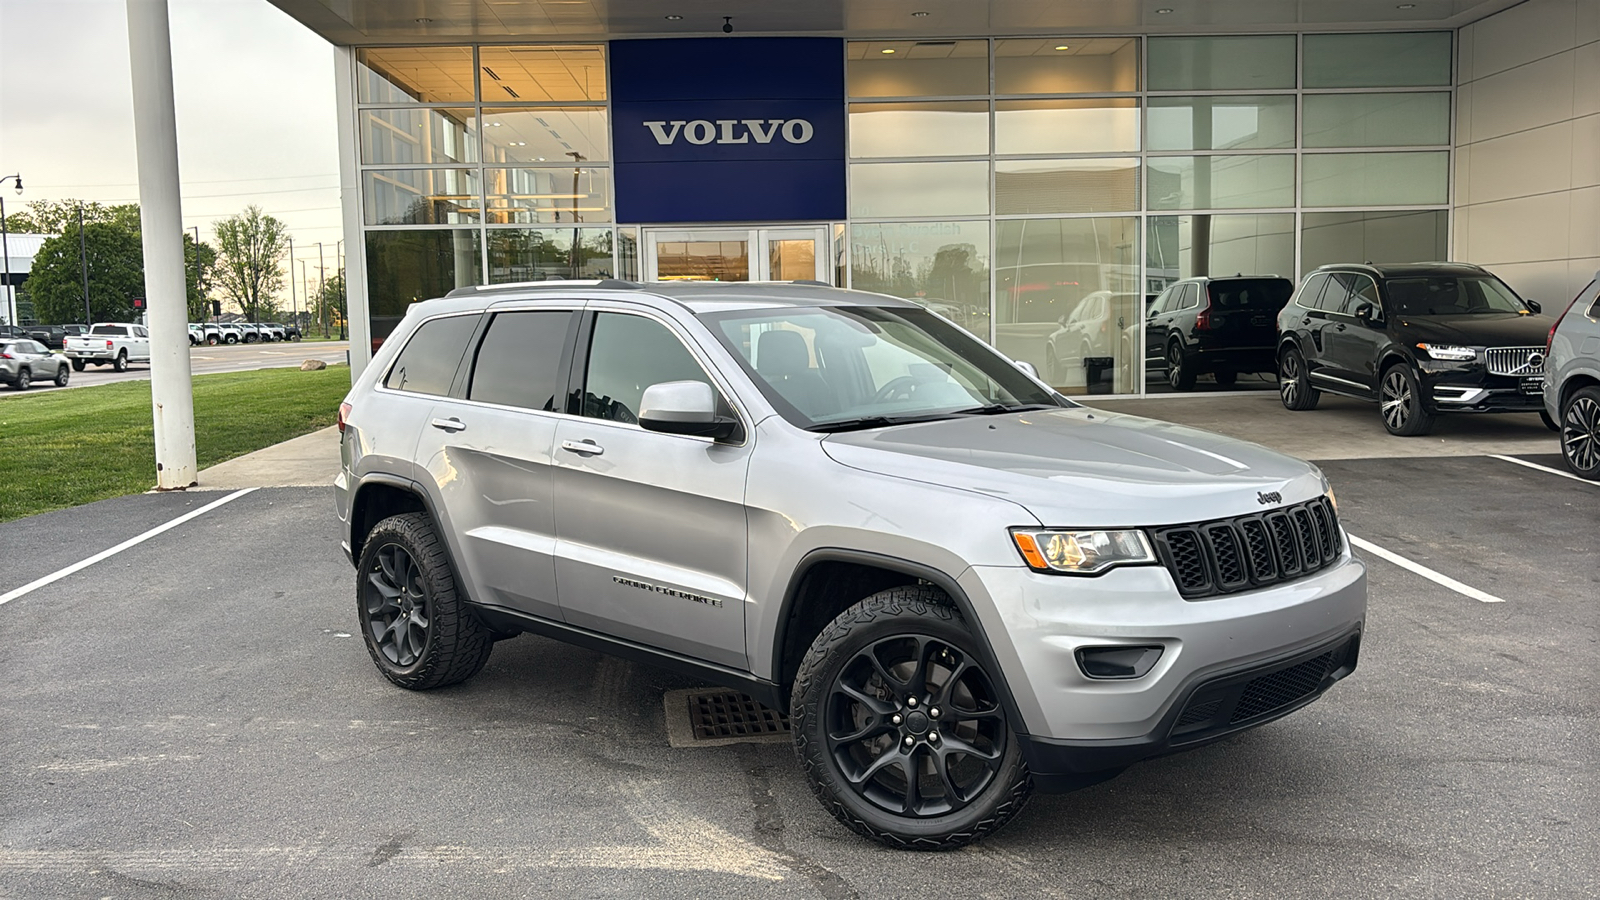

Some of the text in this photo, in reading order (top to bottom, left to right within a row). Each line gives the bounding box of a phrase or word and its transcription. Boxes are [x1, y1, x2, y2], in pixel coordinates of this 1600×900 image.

[643, 119, 814, 145] VOLVO
[898, 223, 961, 235] Swedish
[891, 240, 920, 254] LLC
[1256, 491, 1282, 505] Jeep
[612, 576, 723, 608] GRAND CHEROKEE
